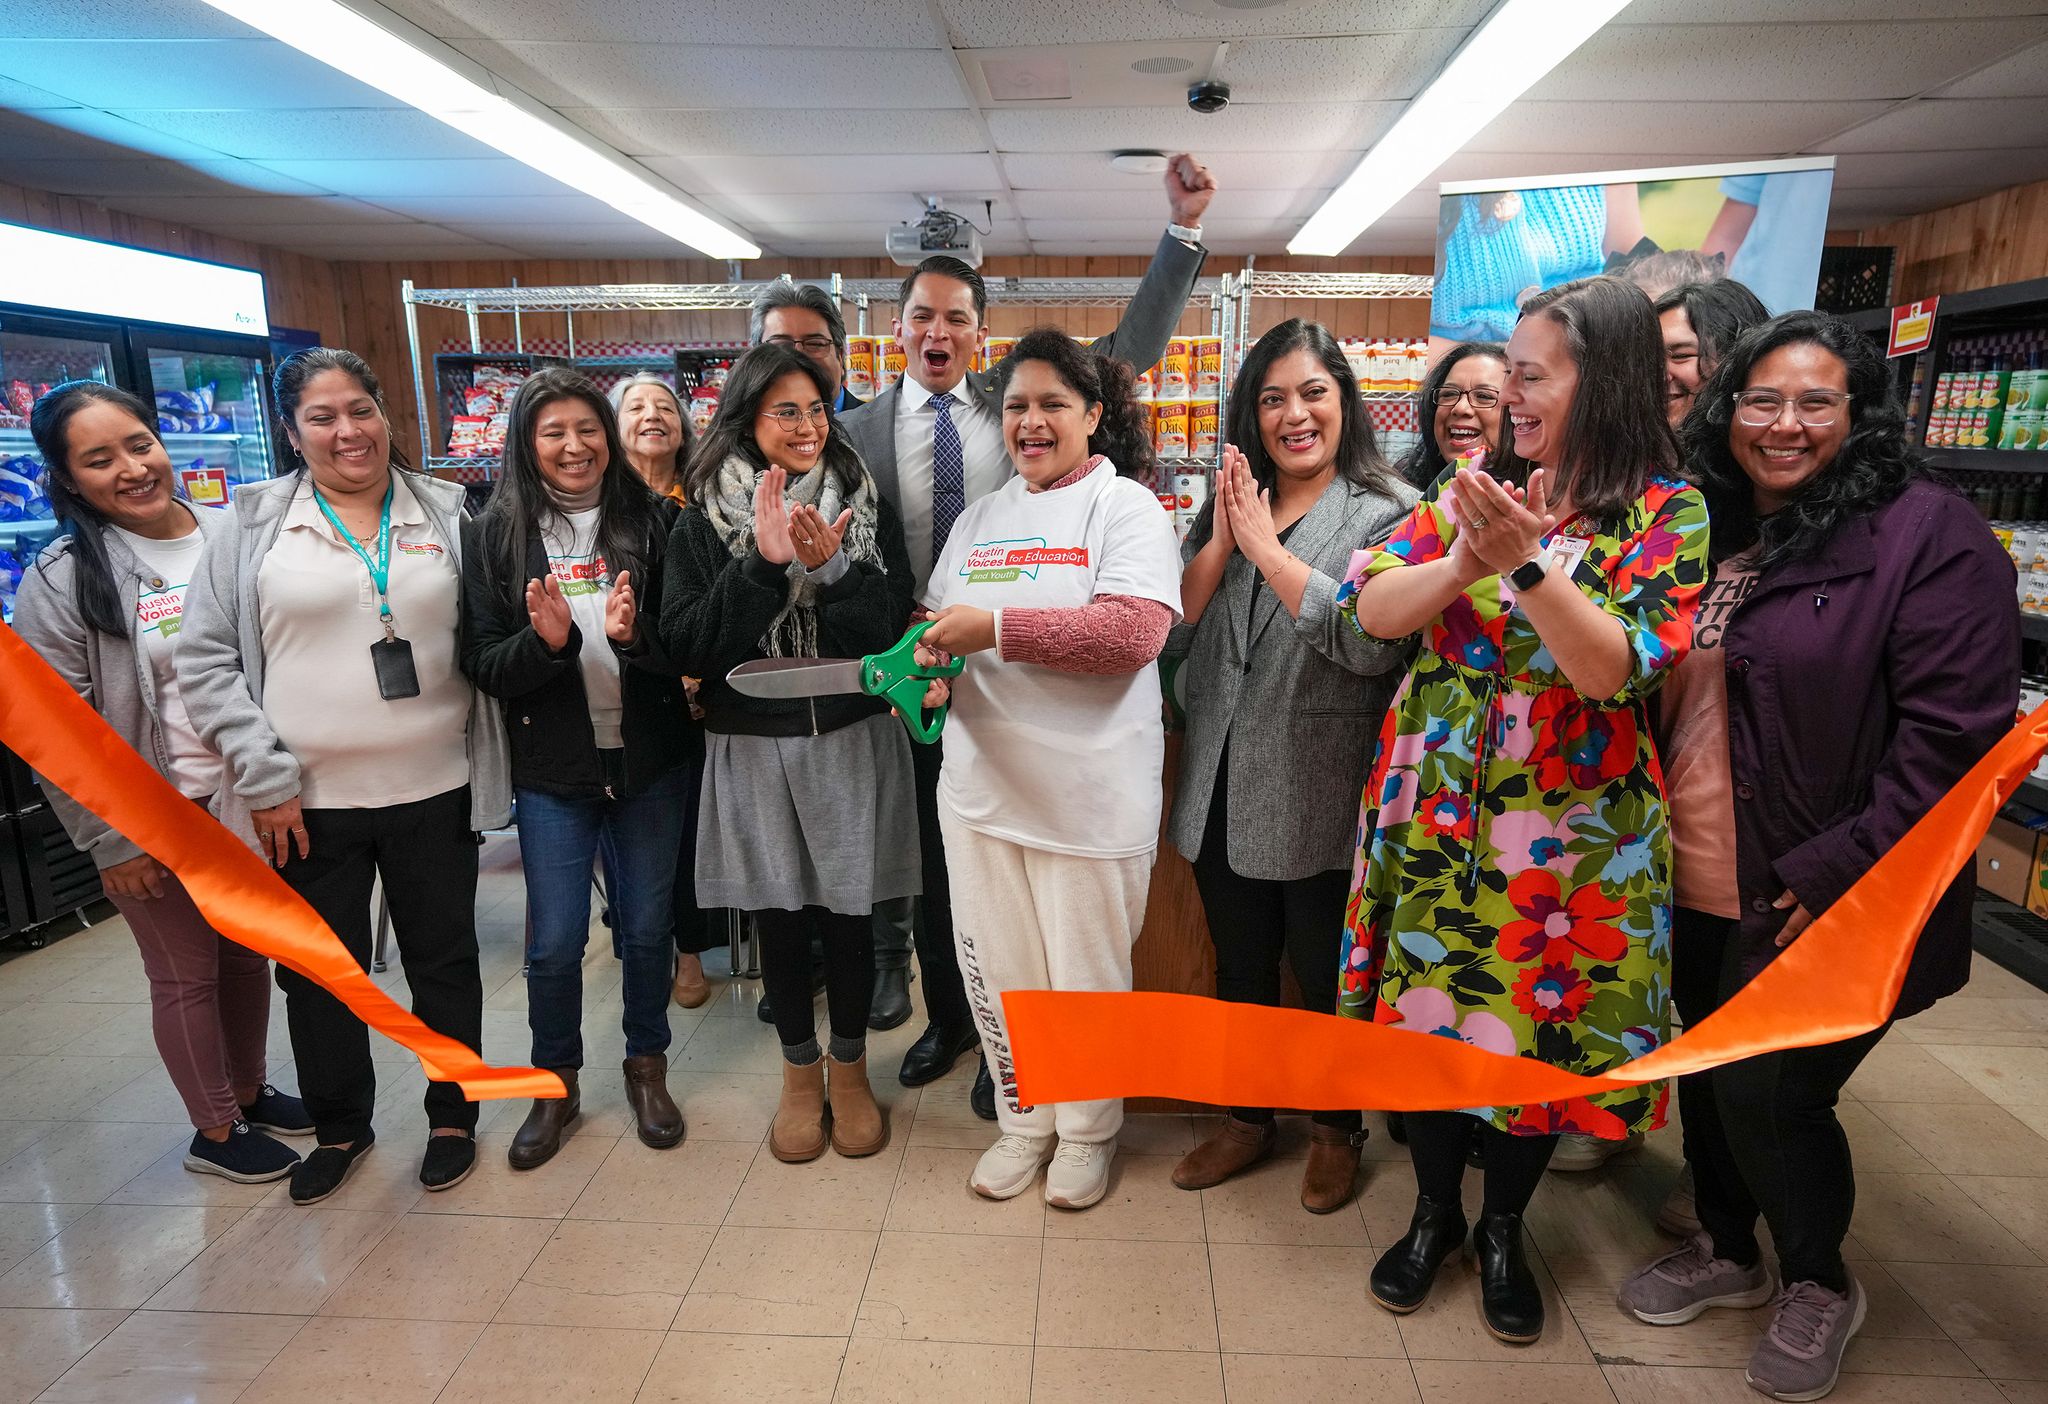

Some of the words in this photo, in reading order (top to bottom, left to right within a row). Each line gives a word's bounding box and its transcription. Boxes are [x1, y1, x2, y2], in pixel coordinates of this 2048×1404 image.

[1165, 347, 1181, 355] OLD
[879, 358, 902, 372] Oats
[1158, 359, 1182, 374] Oats
[1194, 359, 1219, 374] Oats
[1161, 407, 1182, 418] GOLD
[1195, 407, 1216, 418] GOLD
[1159, 419, 1183, 435] Oats
[1193, 419, 1218, 435] Oats
[970, 546, 1004, 558] Austin
[1009, 554, 1023, 563] for
[1025, 551, 1084, 563] Education
[967, 558, 1004, 568] Voices
[972, 572, 988, 580] and
[990, 571, 1015, 579] Youth
[136, 594, 181, 612] Austin
[138, 605, 183, 623] Voice
[165, 622, 181, 631] an
